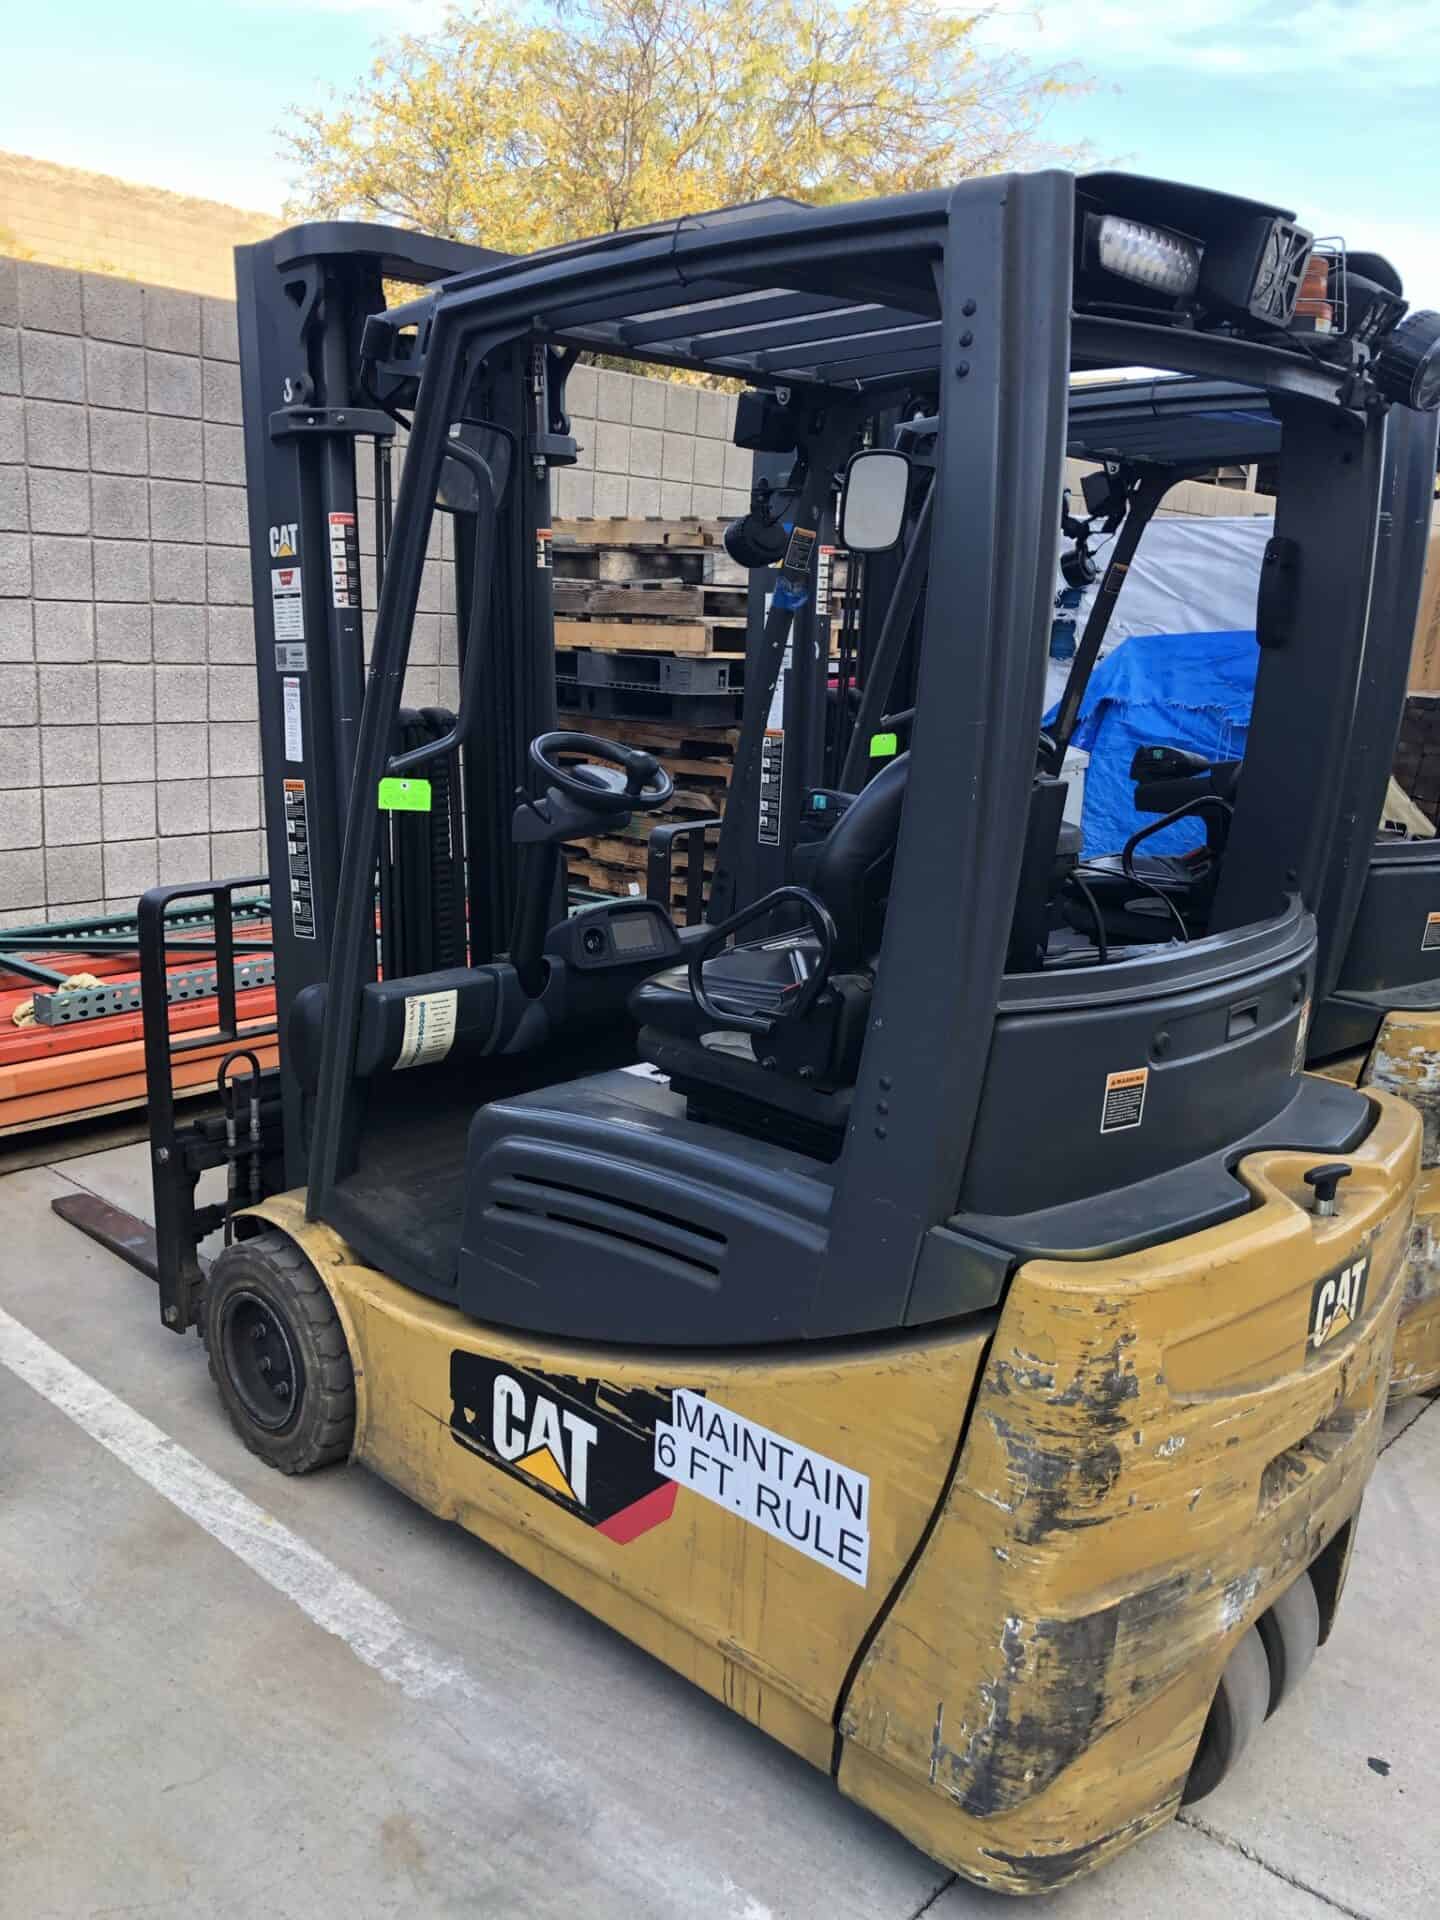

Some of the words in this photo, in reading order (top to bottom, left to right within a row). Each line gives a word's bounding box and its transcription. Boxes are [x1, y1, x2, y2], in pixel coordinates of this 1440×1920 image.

[269, 523, 298, 558] CAT
[1313, 1257, 1367, 1347] CAT
[492, 1374, 598, 1507] CAT
[677, 1395, 863, 1520] MAINTAIN
[658, 1433, 677, 1469] 6
[689, 1448, 741, 1506] FT.
[757, 1484, 864, 1575] RULE
